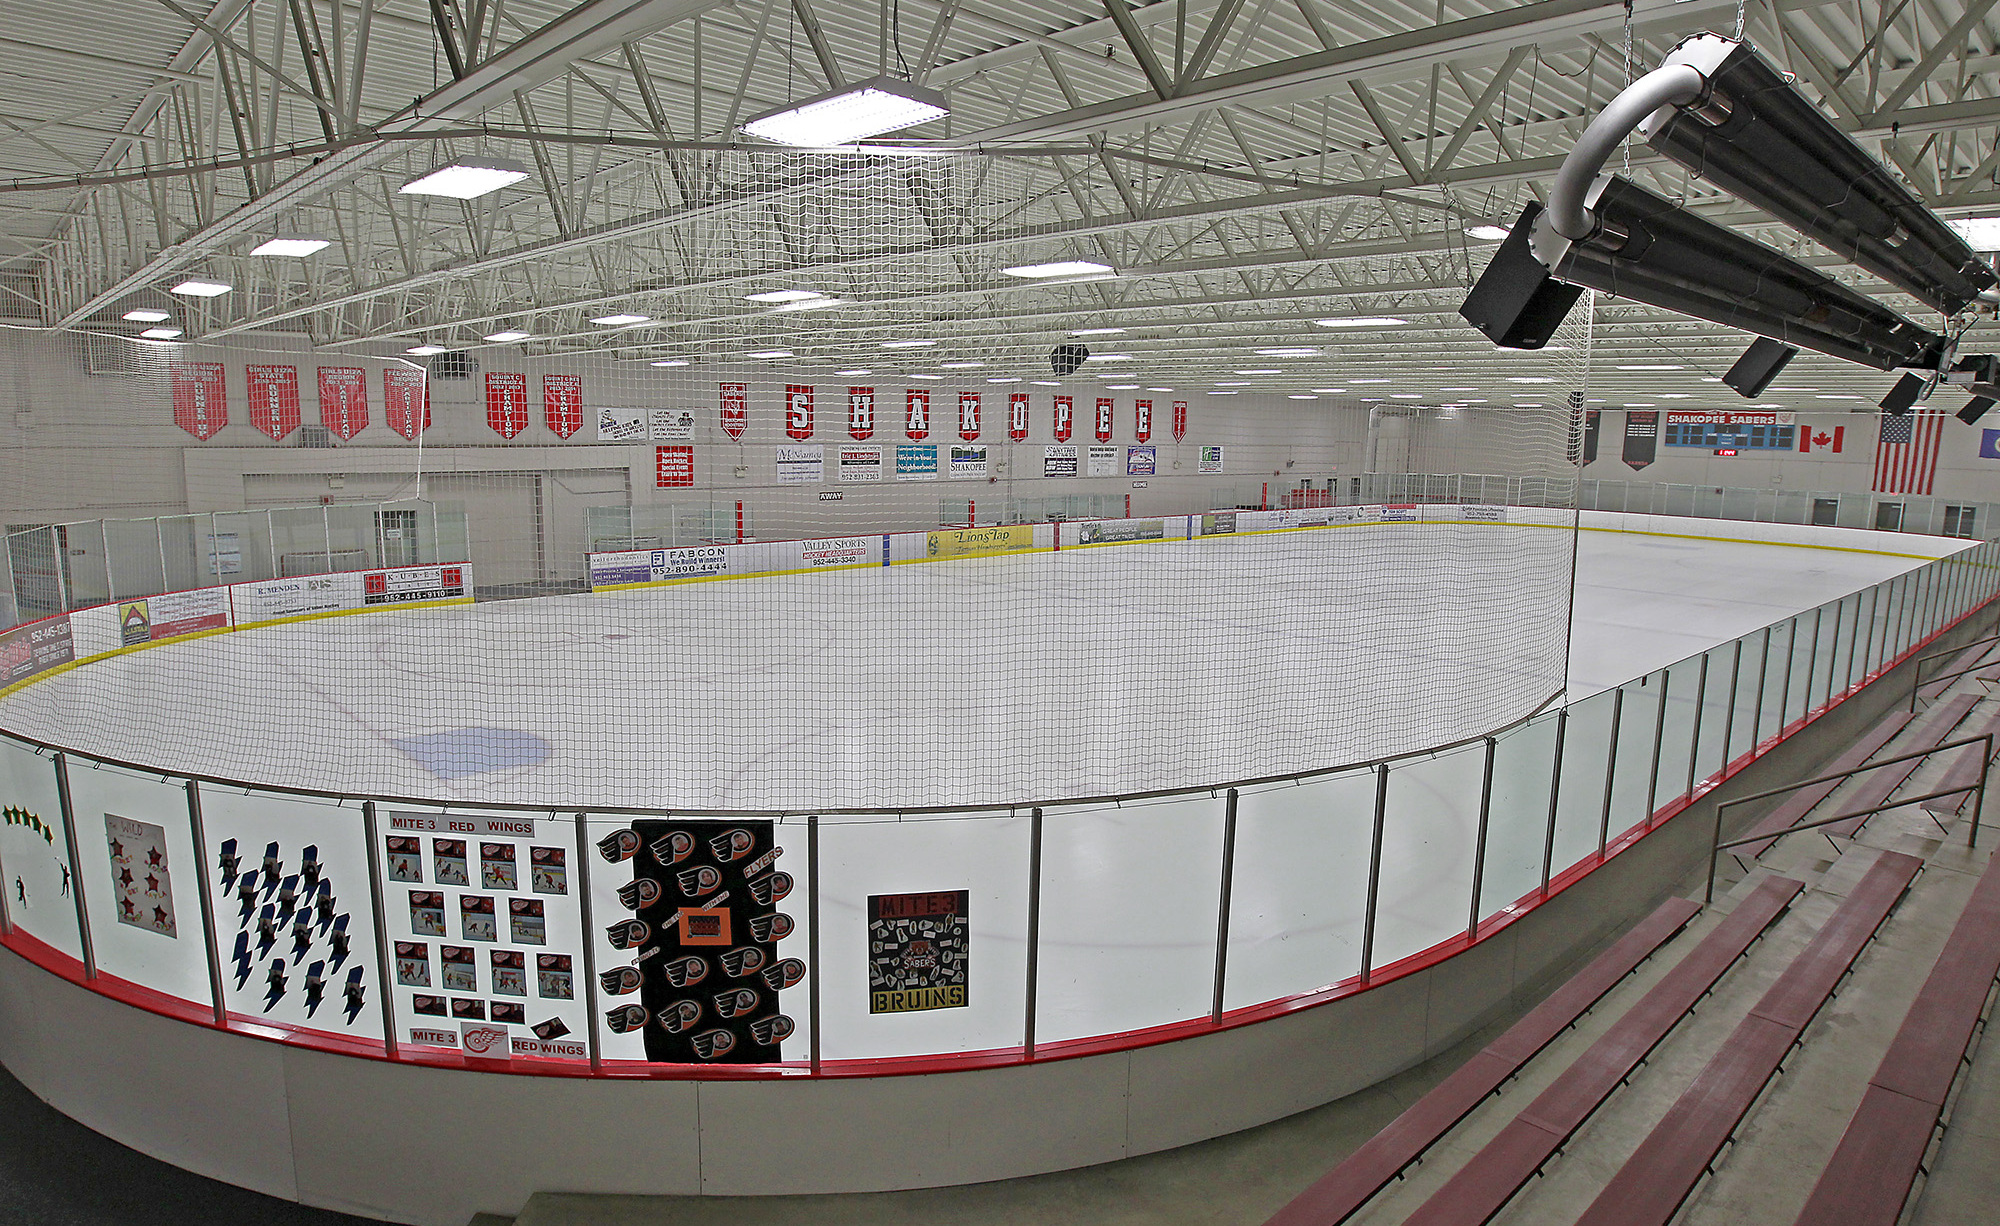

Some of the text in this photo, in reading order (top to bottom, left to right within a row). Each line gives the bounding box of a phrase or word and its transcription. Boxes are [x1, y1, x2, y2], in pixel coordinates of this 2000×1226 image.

[268, 383, 281, 437] RUNNER UP
[503, 389, 513, 438] CHAMPIONS
[559, 390, 569, 438] CHAMPIONS
[1668, 414, 1726, 424] SHAKOPEE
[1729, 416, 1775, 425] SABERS
[950, 462, 986, 471] SHAKOPEE
[820, 492, 843, 500] AWAY
[954, 528, 1010, 544] Lions Tap
[803, 539, 866, 551] VALLEY SPORTS
[670, 548, 725, 559] FABCON
[653, 562, 728, 575] 952-890-4444
[670, 559, 680, 567] We
[384, 590, 446, 602] 952-445-9110
[121, 821, 143, 836] WILD
[392, 817, 532, 834] MITE 3 RED WINGS
[744, 847, 783, 878] FLYERS
[904, 958, 936, 970] SABERS
[875, 986, 963, 1012] BRUINS
[413, 1032, 585, 1056] MITE 3 RED WINGS
